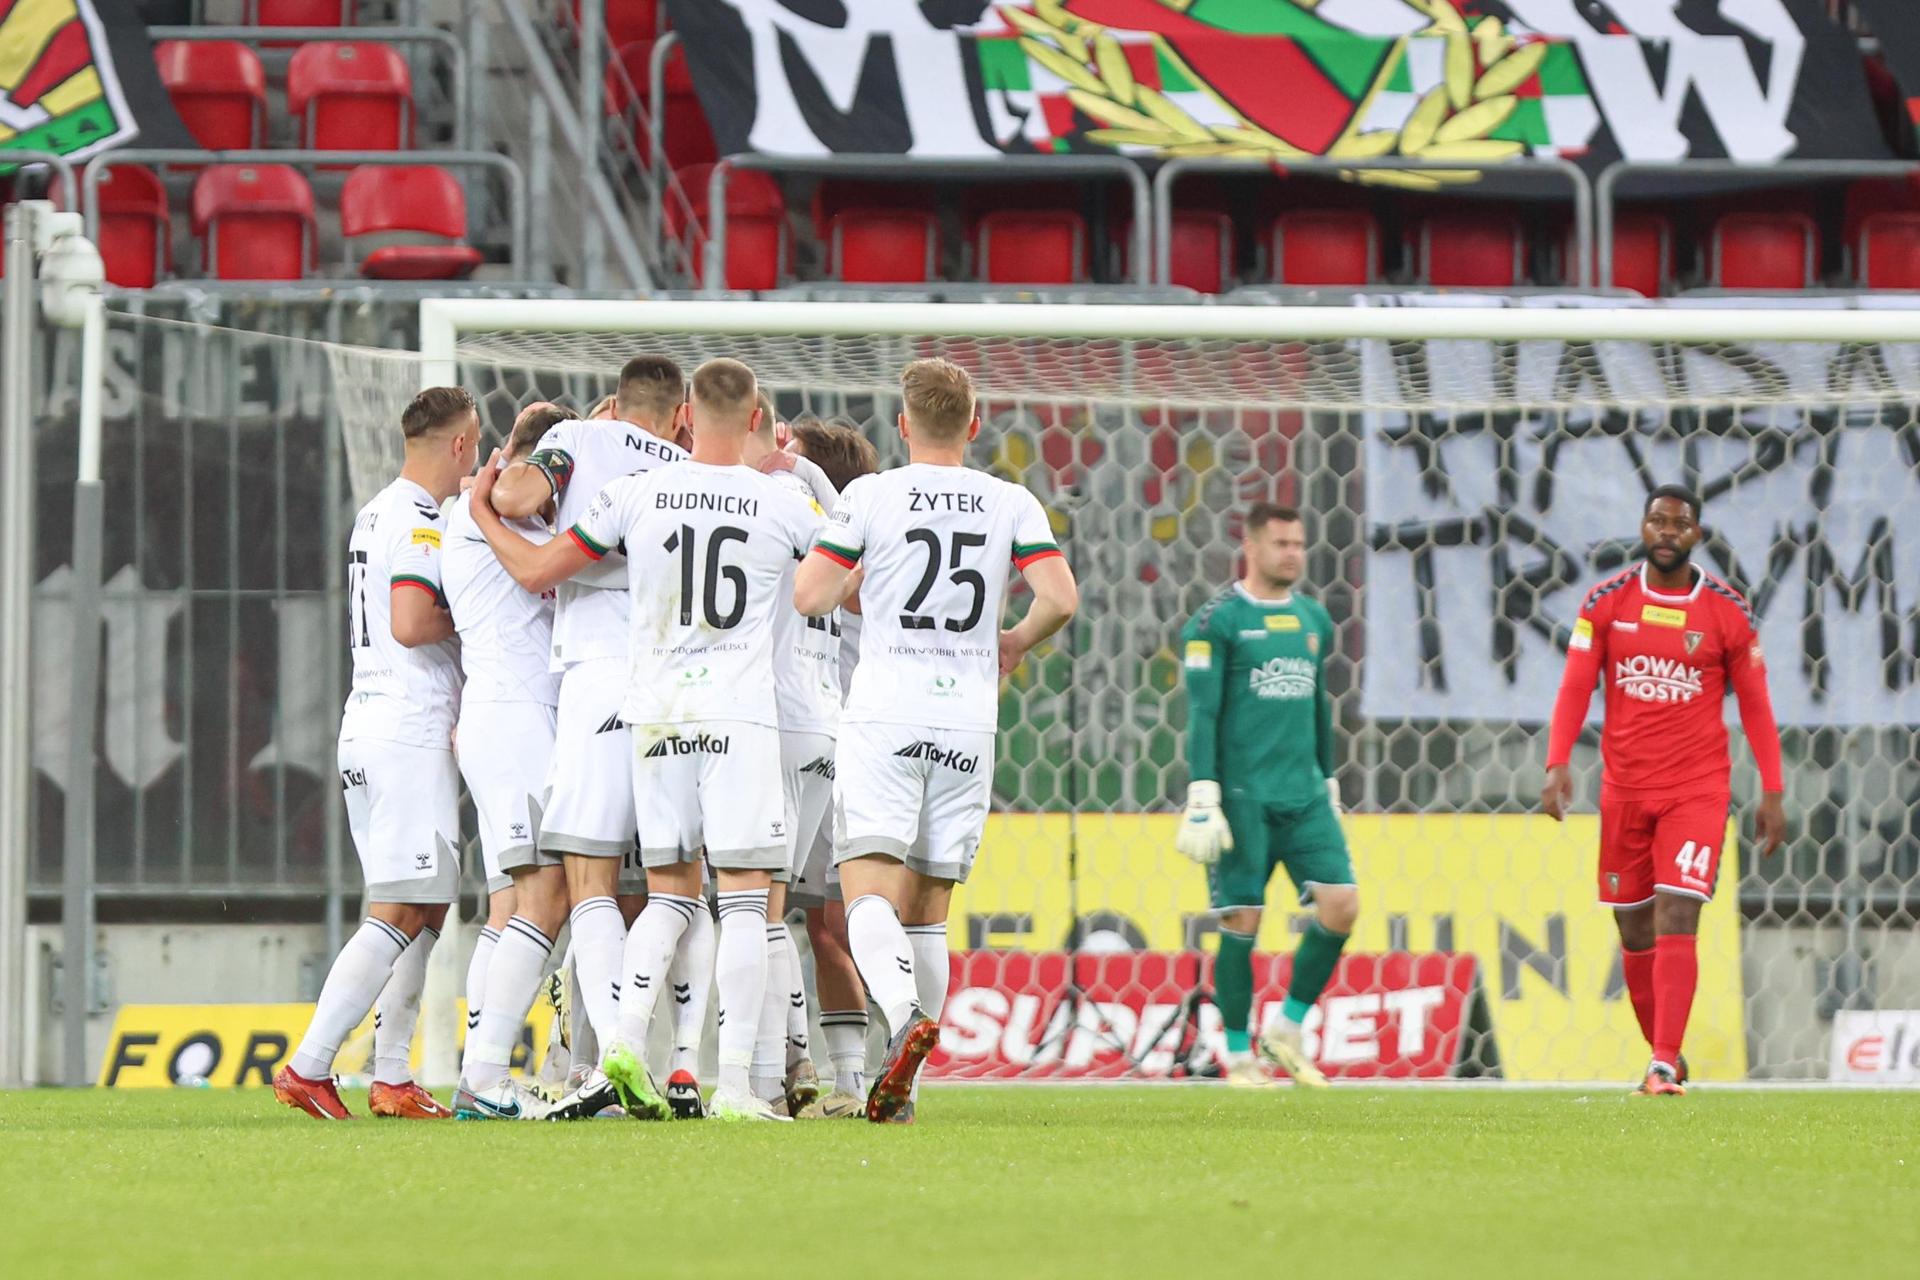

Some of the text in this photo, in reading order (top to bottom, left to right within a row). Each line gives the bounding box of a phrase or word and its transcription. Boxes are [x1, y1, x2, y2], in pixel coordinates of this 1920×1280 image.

[624, 433, 688, 462] NEDI
[655, 492, 758, 517] BUDNICKI
[908, 486, 986, 513] ŻYTEK
[662, 523, 749, 630] 16
[899, 527, 987, 633] 25
[1615, 655, 1703, 686] NOWAK
[1623, 682, 1694, 704] MOSTY
[667, 735, 730, 756] TorKol
[921, 740, 979, 775] TorKol
[1674, 840, 1712, 877] 44
